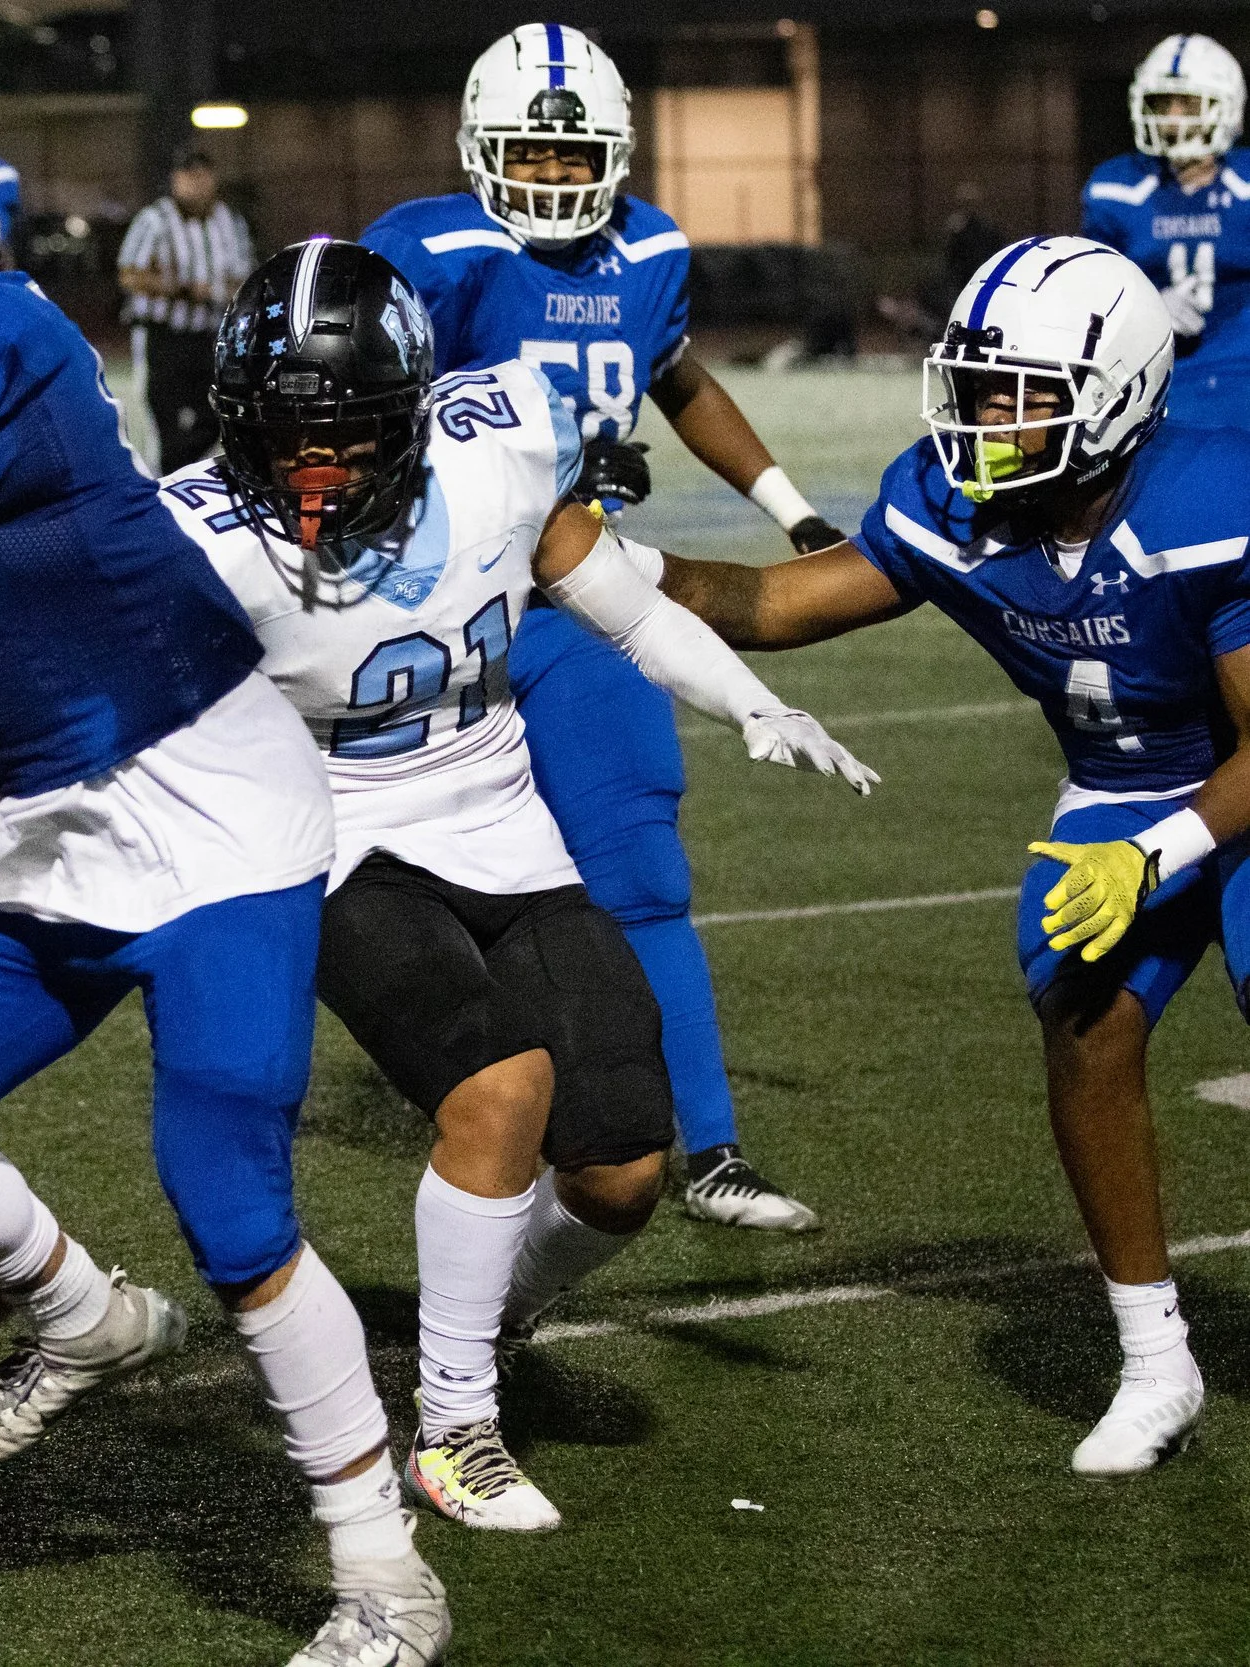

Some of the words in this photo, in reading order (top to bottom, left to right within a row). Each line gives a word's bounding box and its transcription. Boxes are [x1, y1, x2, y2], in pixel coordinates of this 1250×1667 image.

[545, 293, 621, 325] CORSAIRS
[1077, 459, 1110, 485] schutt
[391, 579, 422, 603] MC
[1002, 610, 1132, 646] CORSAIRS
[328, 591, 512, 760] 21
[1065, 658, 1146, 753] 4
